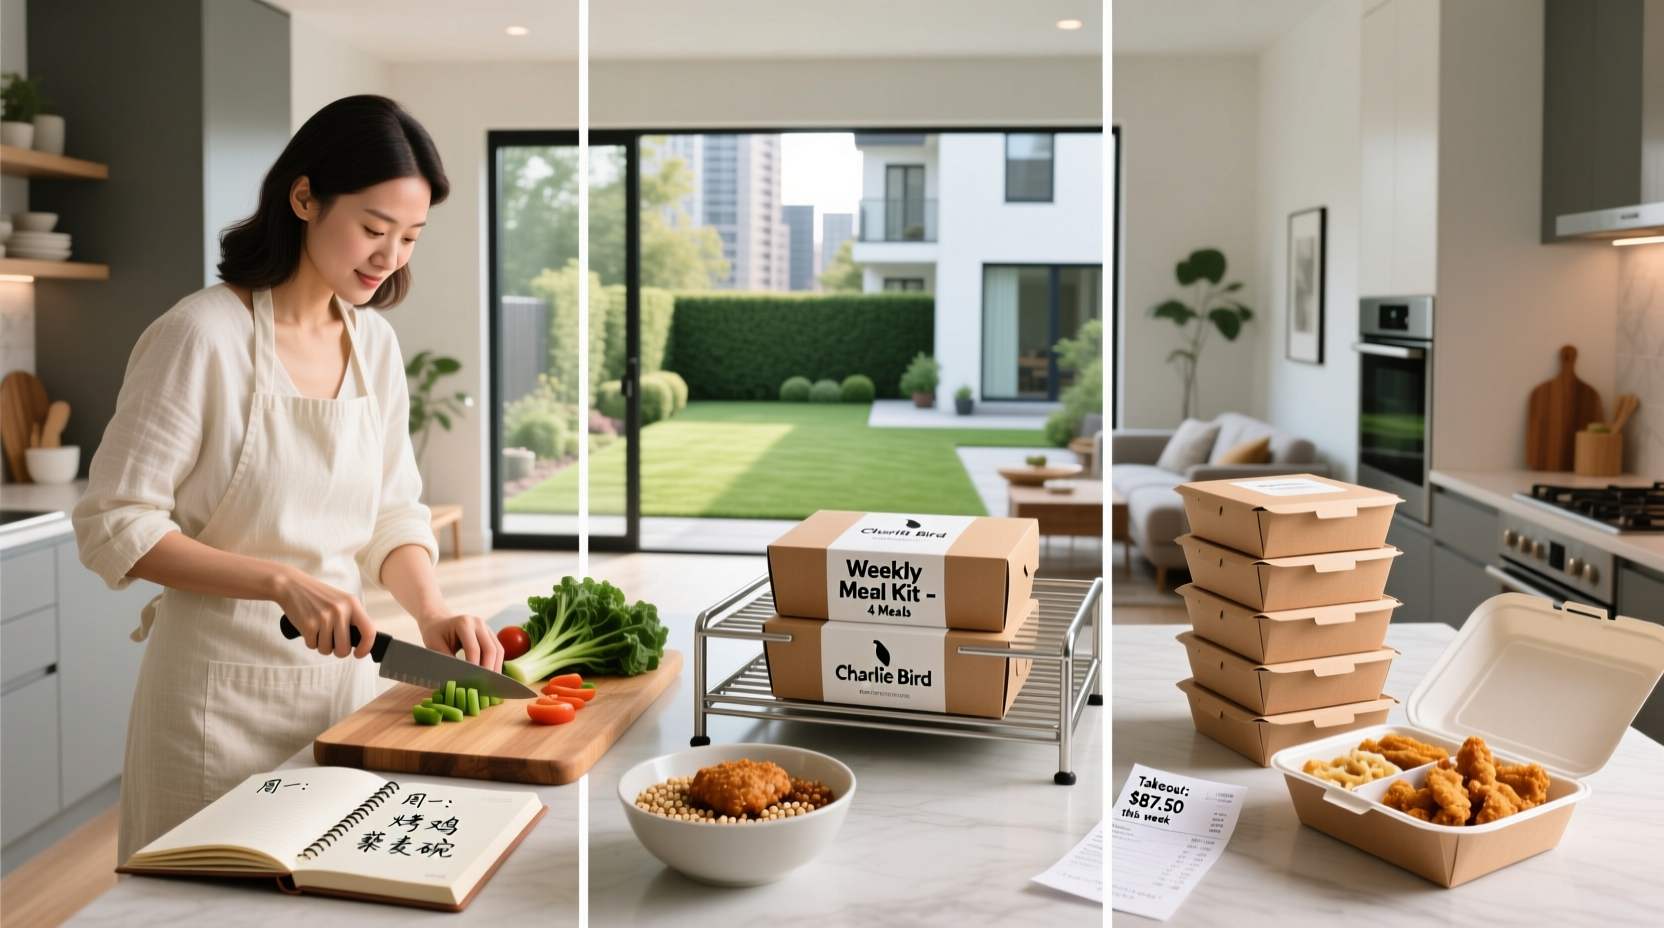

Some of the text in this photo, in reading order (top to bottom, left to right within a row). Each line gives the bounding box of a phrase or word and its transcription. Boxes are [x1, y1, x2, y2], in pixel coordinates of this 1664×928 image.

[915, 531, 947, 539] Bird
[846, 559, 922, 584] Weekly
[839, 581, 886, 600] Meal
[892, 583, 921, 602] Kit
[867, 604, 911, 618] 4 Meals
[835, 664, 932, 687] Charlie Bird
[1139, 775, 1189, 797] Takeout:
[1129, 790, 1185, 814] $87.50
[1144, 814, 1171, 826] week
